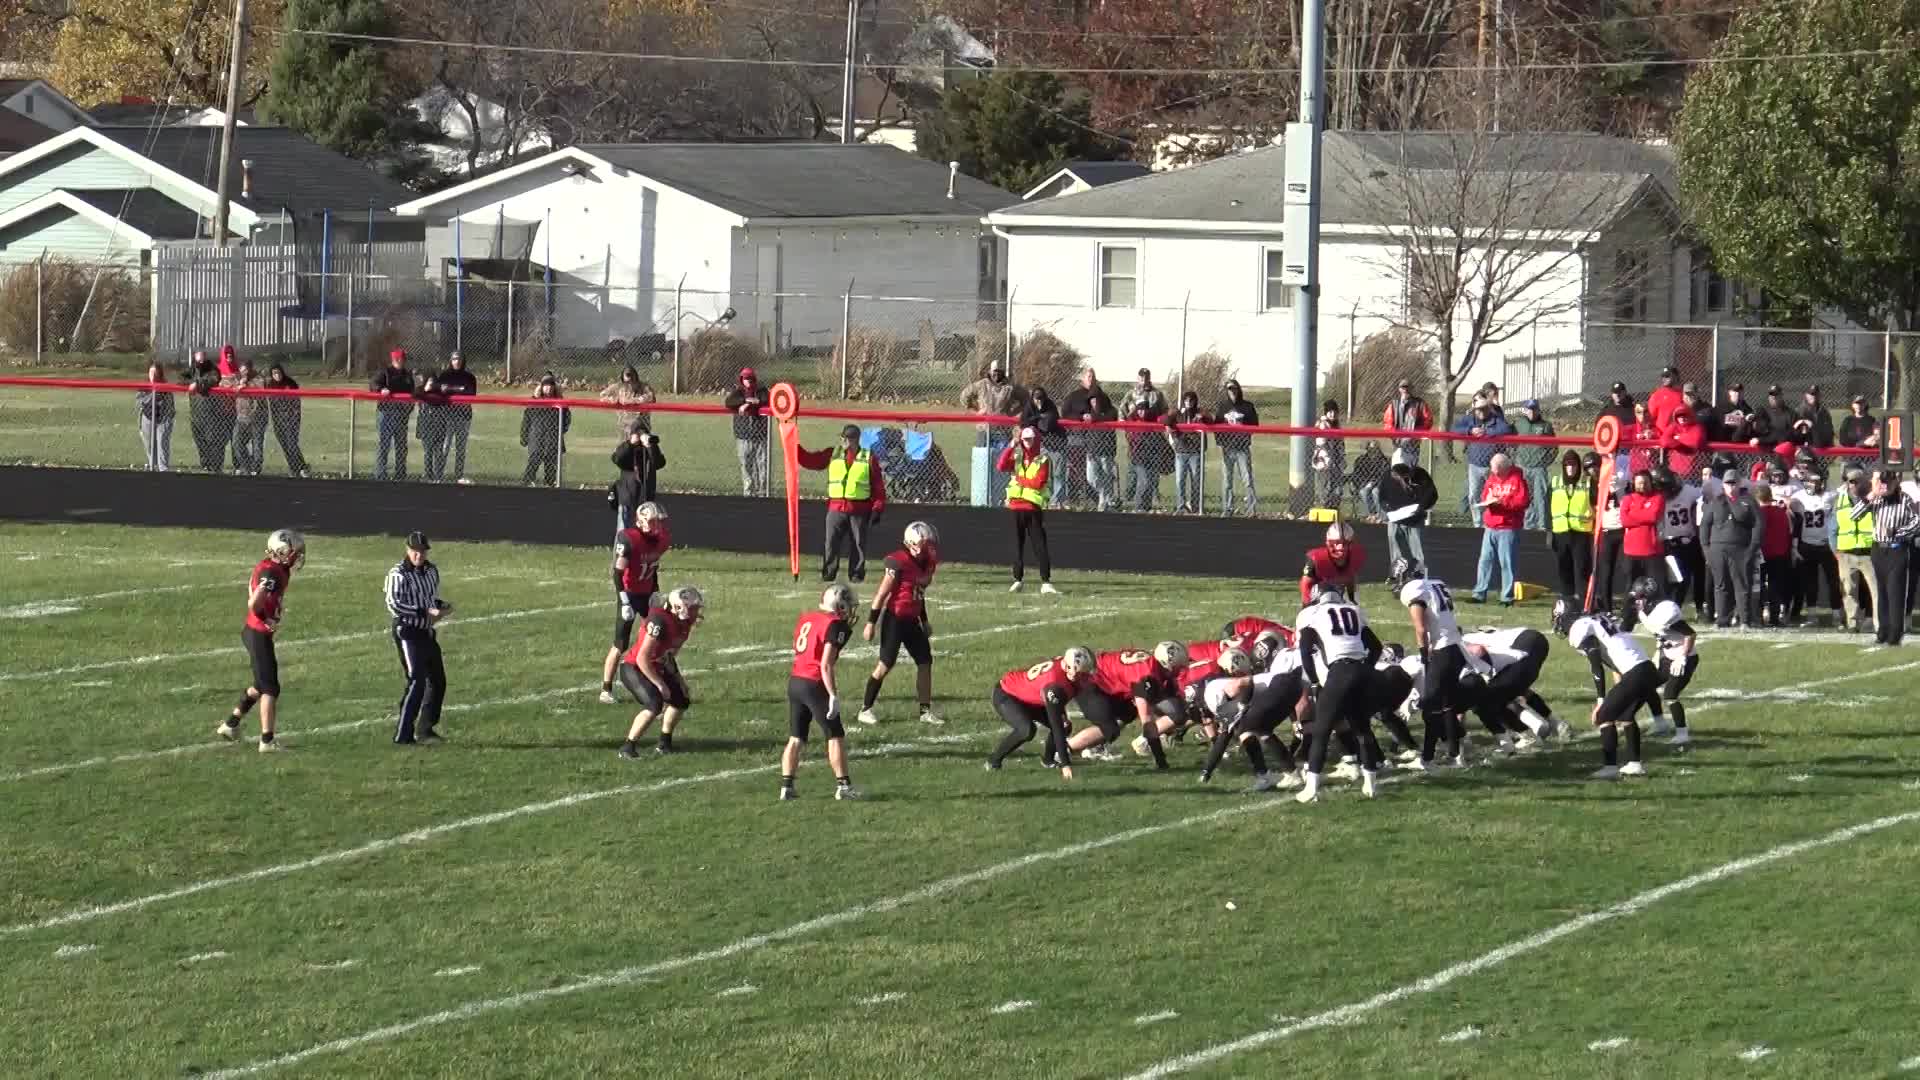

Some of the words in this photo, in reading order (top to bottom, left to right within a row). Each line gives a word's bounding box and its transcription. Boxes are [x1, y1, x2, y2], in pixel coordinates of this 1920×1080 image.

[1888, 416, 1902, 449] 1
[1667, 507, 1689, 527] 33
[1804, 509, 1825, 529] 23
[1327, 607, 1359, 636] 10
[795, 622, 811, 653] 8
